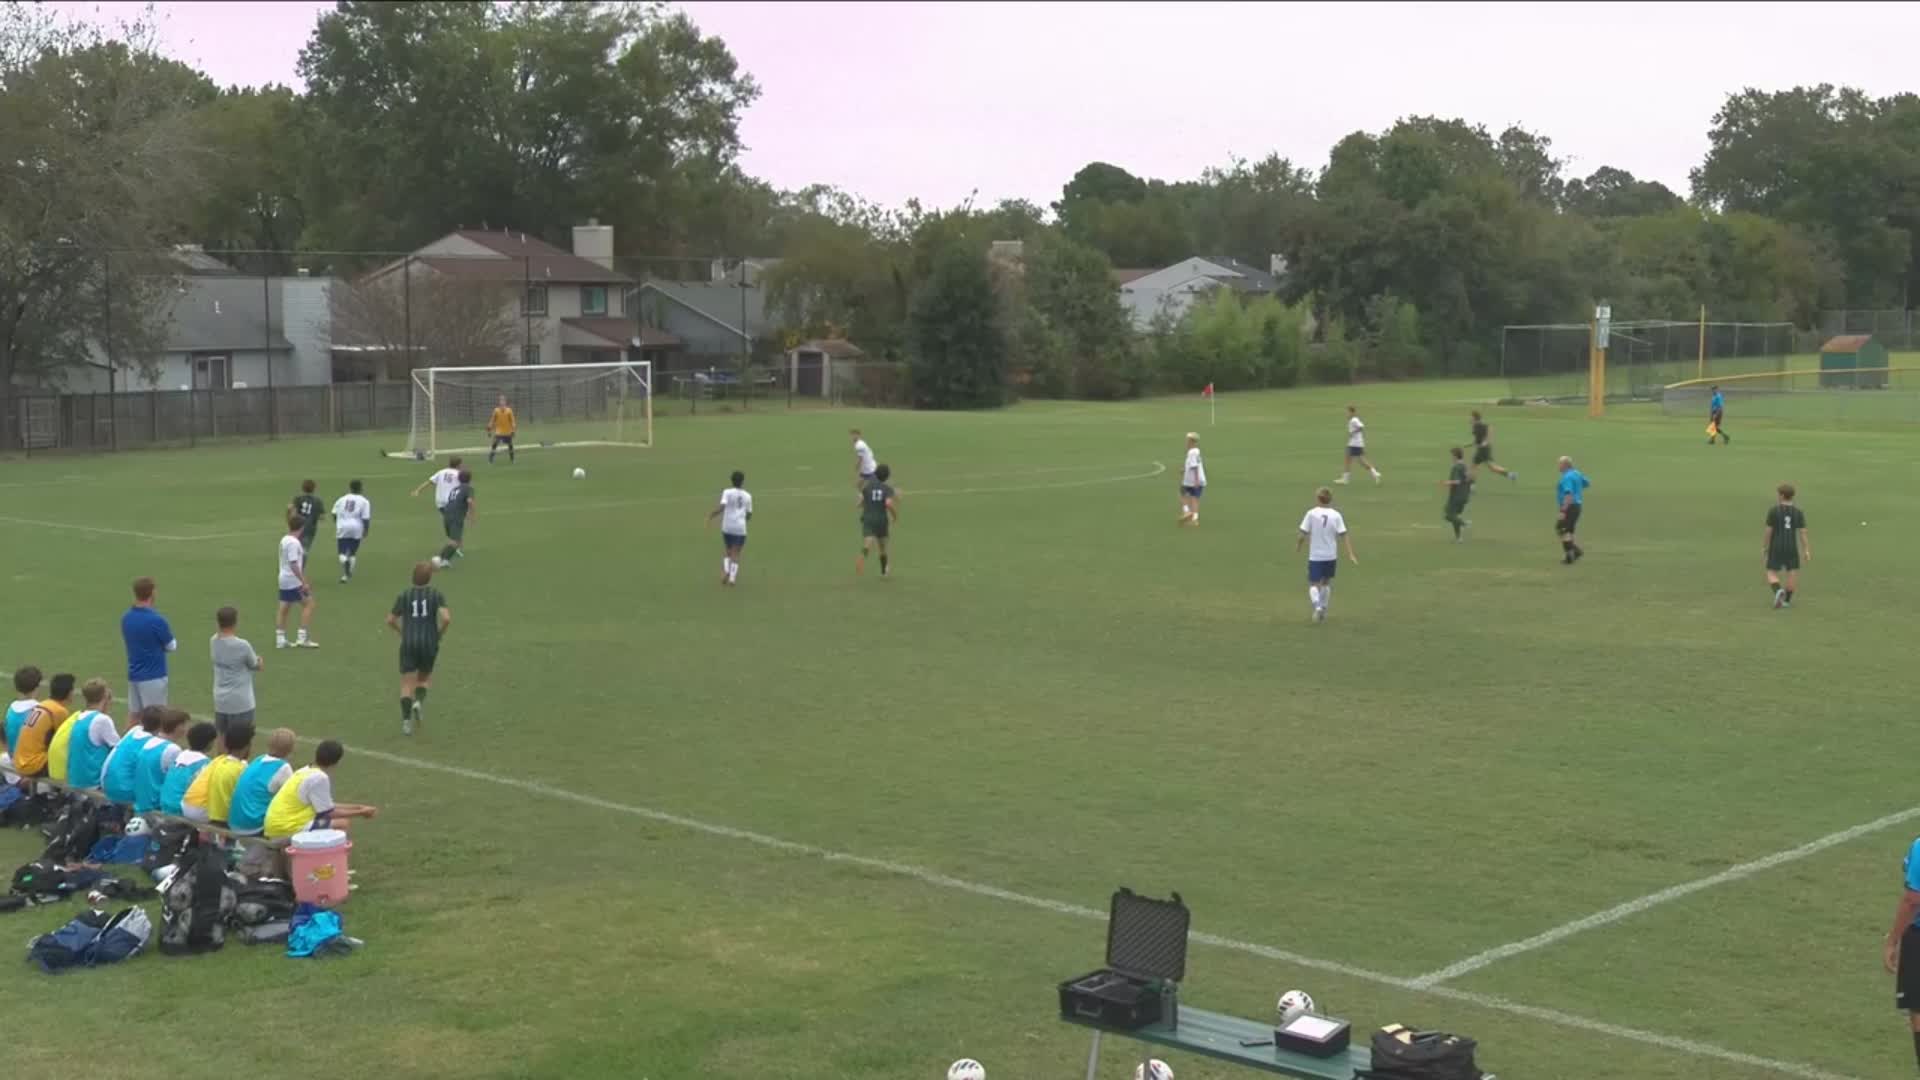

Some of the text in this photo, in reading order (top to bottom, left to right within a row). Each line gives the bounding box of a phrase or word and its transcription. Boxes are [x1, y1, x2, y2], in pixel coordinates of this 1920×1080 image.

[1321, 514, 1329, 529] 7
[1784, 515, 1792, 529] 2
[411, 599, 428, 618] 11
